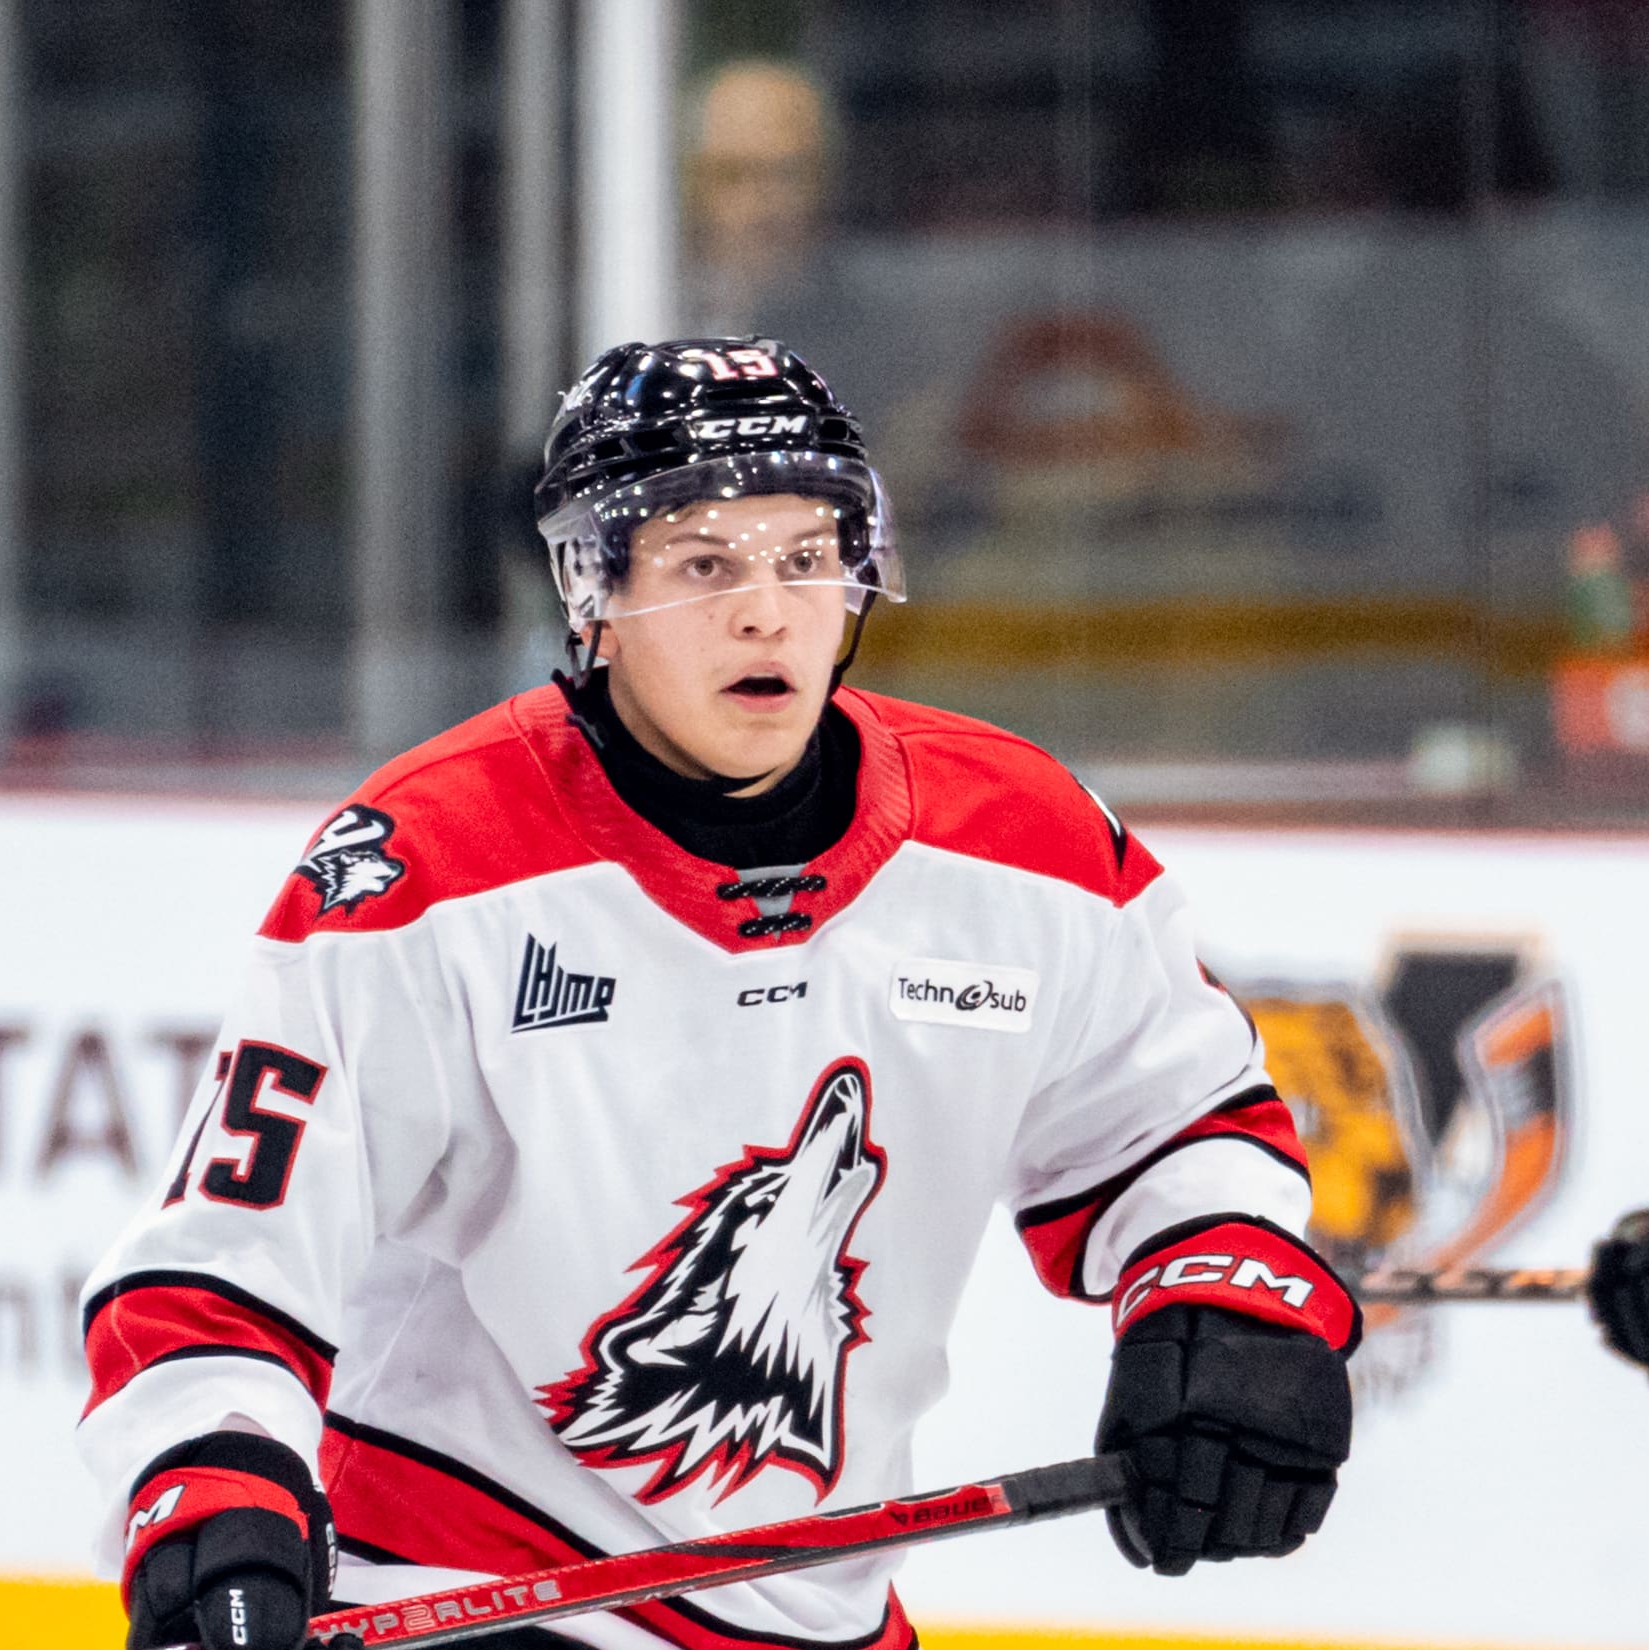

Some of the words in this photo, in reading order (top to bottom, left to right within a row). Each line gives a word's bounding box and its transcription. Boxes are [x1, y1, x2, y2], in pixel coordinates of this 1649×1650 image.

[699, 416, 807, 439] CCM
[1116, 1254, 1314, 1328] CCM
[229, 1589, 248, 1646] CCM
